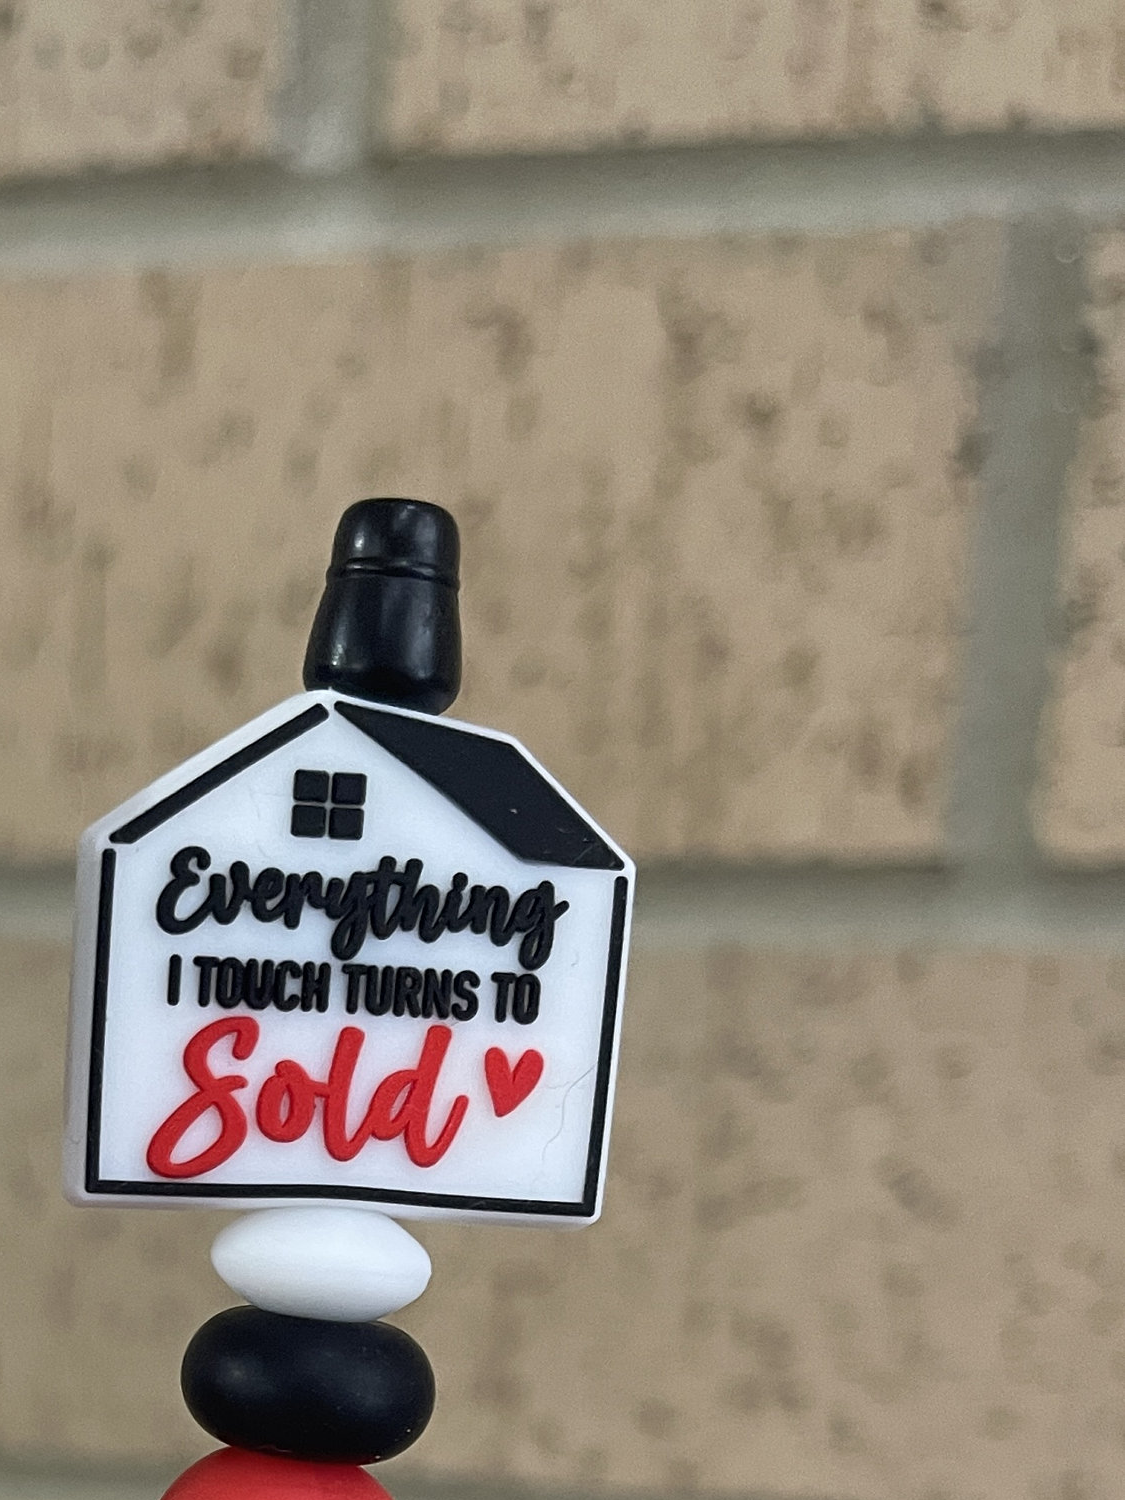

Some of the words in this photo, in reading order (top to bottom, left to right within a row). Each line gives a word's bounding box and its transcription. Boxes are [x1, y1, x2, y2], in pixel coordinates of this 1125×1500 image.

[156, 845, 570, 971] Everything
[167, 954, 182, 1006] I
[193, 956, 331, 1014] TOUCH
[341, 964, 481, 1021] TURNS
[491, 971, 541, 1026] TO
[146, 1015, 470, 1179] Sold
